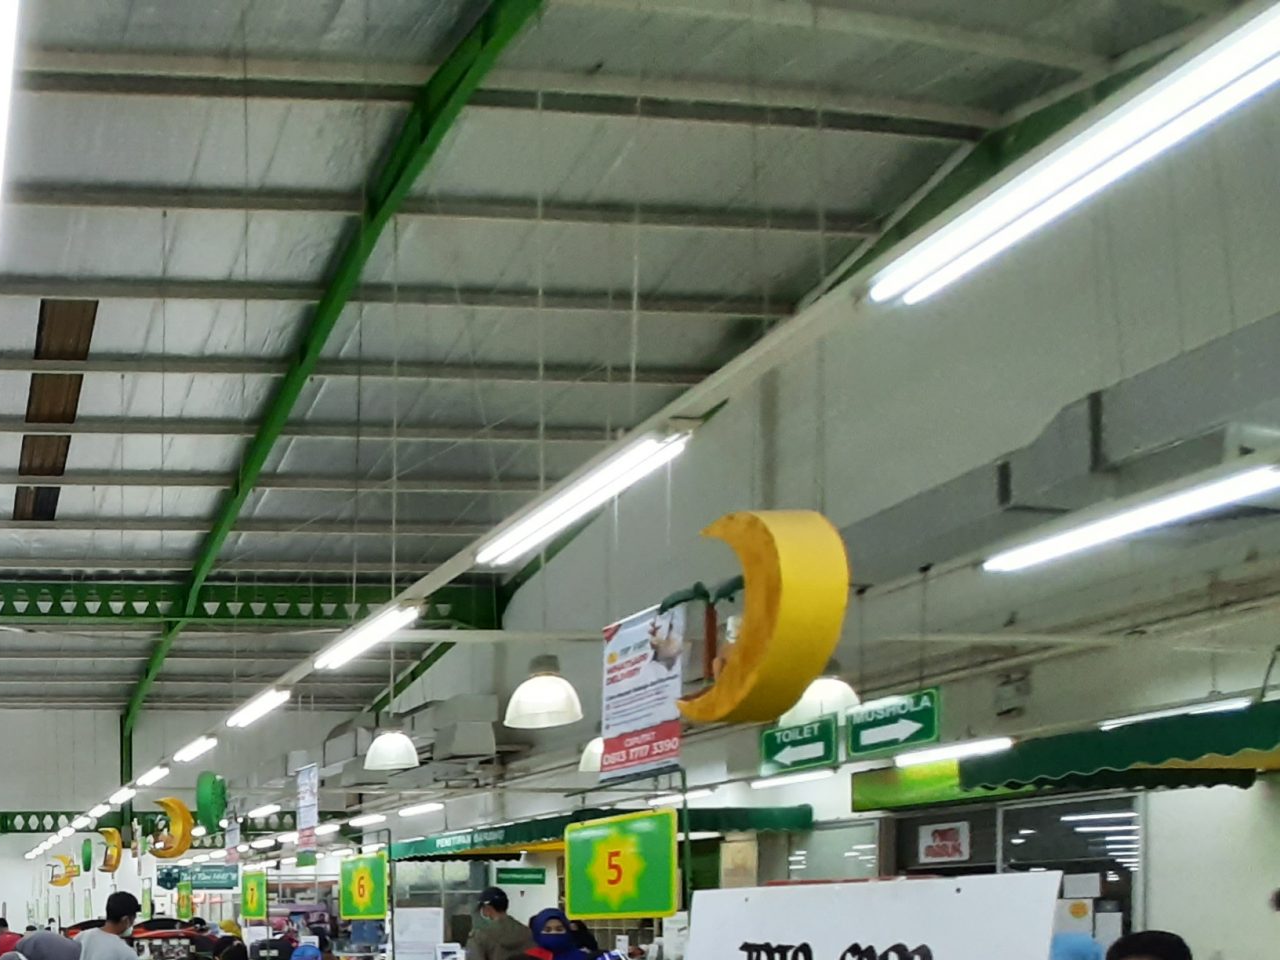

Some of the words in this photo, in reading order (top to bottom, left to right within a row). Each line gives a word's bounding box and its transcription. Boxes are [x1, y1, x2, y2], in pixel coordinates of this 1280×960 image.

[852, 694, 932, 724] MUSHOLA
[774, 722, 821, 745] TOILET
[607, 850, 623, 886] 5
[357, 875, 366, 899] 6
